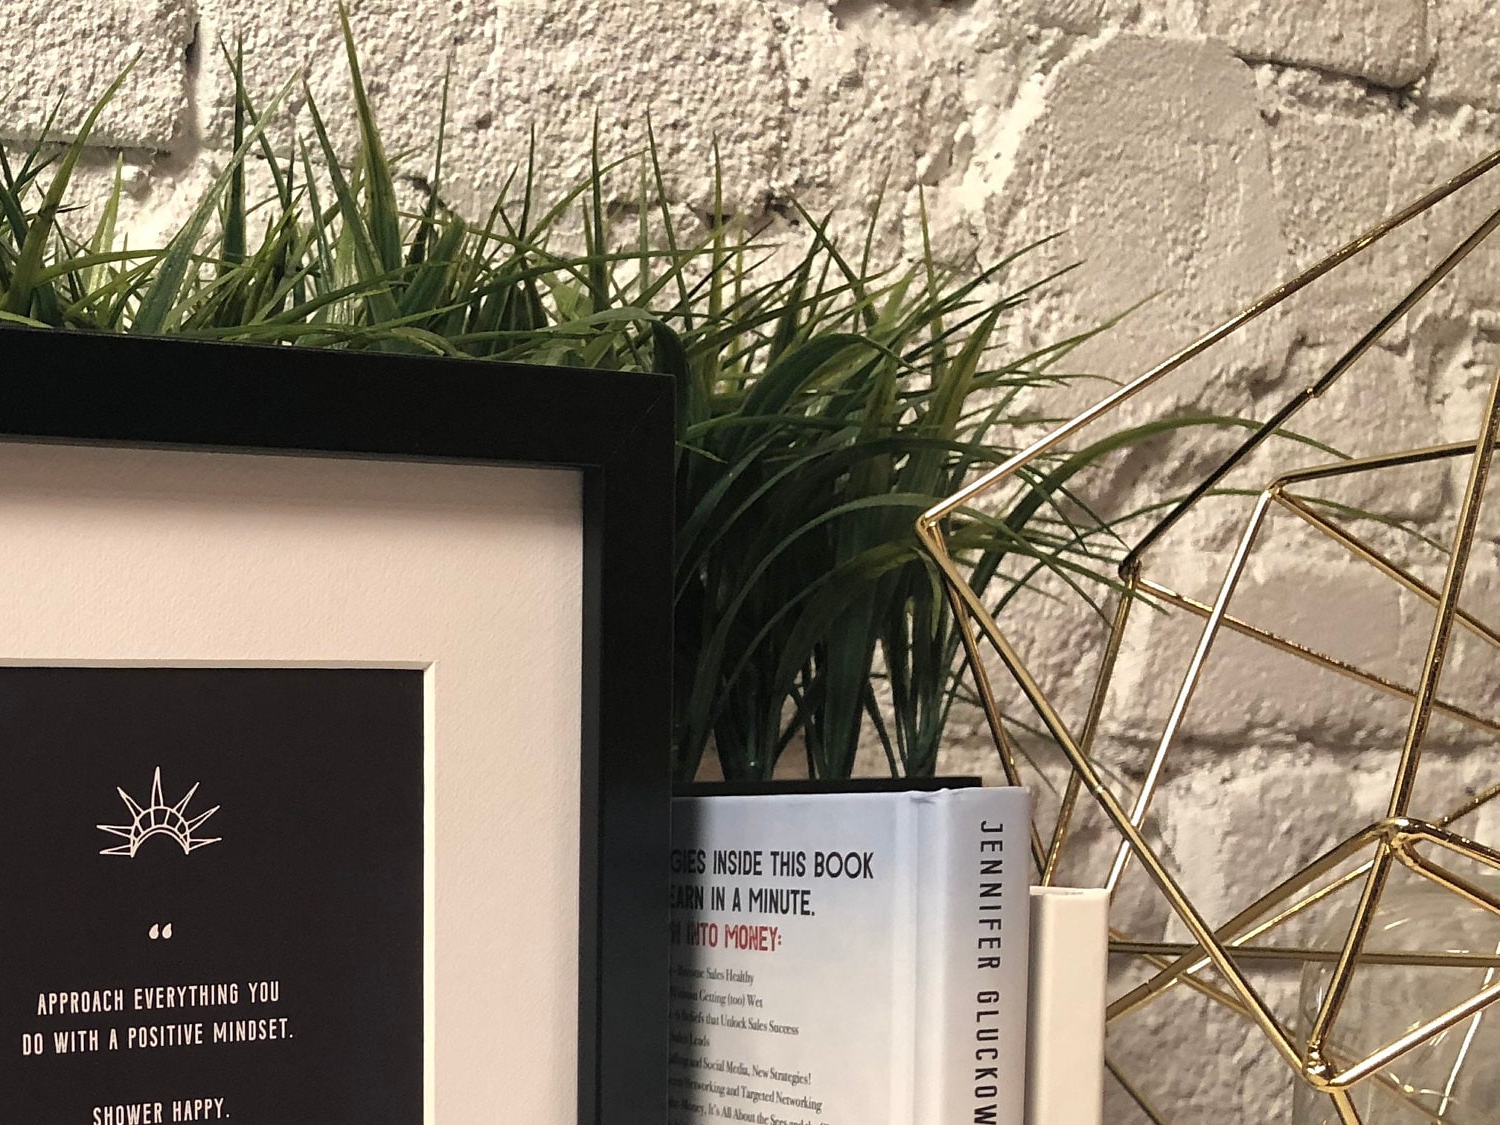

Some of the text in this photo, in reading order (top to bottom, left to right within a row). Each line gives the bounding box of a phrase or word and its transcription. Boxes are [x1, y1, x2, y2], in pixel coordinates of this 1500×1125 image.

[712, 849, 762, 877] INSIDE
[770, 850, 806, 877] THIS
[814, 851, 874, 879] BOOK
[710, 886, 726, 911] IN
[732, 887, 742, 912] A
[748, 888, 816, 915] MINUTE.
[686, 921, 782, 952] INTO MONEY:
[726, 968, 754, 986] Healthy
[973, 820, 1003, 1125] JENNIFER GLUCKOW
[37, 980, 280, 1016] APPROACH EVERYTHING YOU
[728, 992, 746, 1007] (too)
[746, 994, 764, 1008] Wet
[22, 1016, 293, 1056] DO WITH A POSITIVE MINDSET.
[720, 1014, 746, 1029] Unlock
[748, 1017, 768, 1031] Sales
[768, 1019, 800, 1035] Success
[702, 1057, 724, 1072] Social
[752, 1064, 768, 1078] New
[770, 1066, 812, 1087] Strategies!
[172, 1098, 230, 1122] HAPPY.
[726, 1084, 822, 1114] and Targeted Networking
[722, 1105, 732, 1119] All
[732, 1107, 755, 1123] About
[756, 1111, 768, 1125] the
